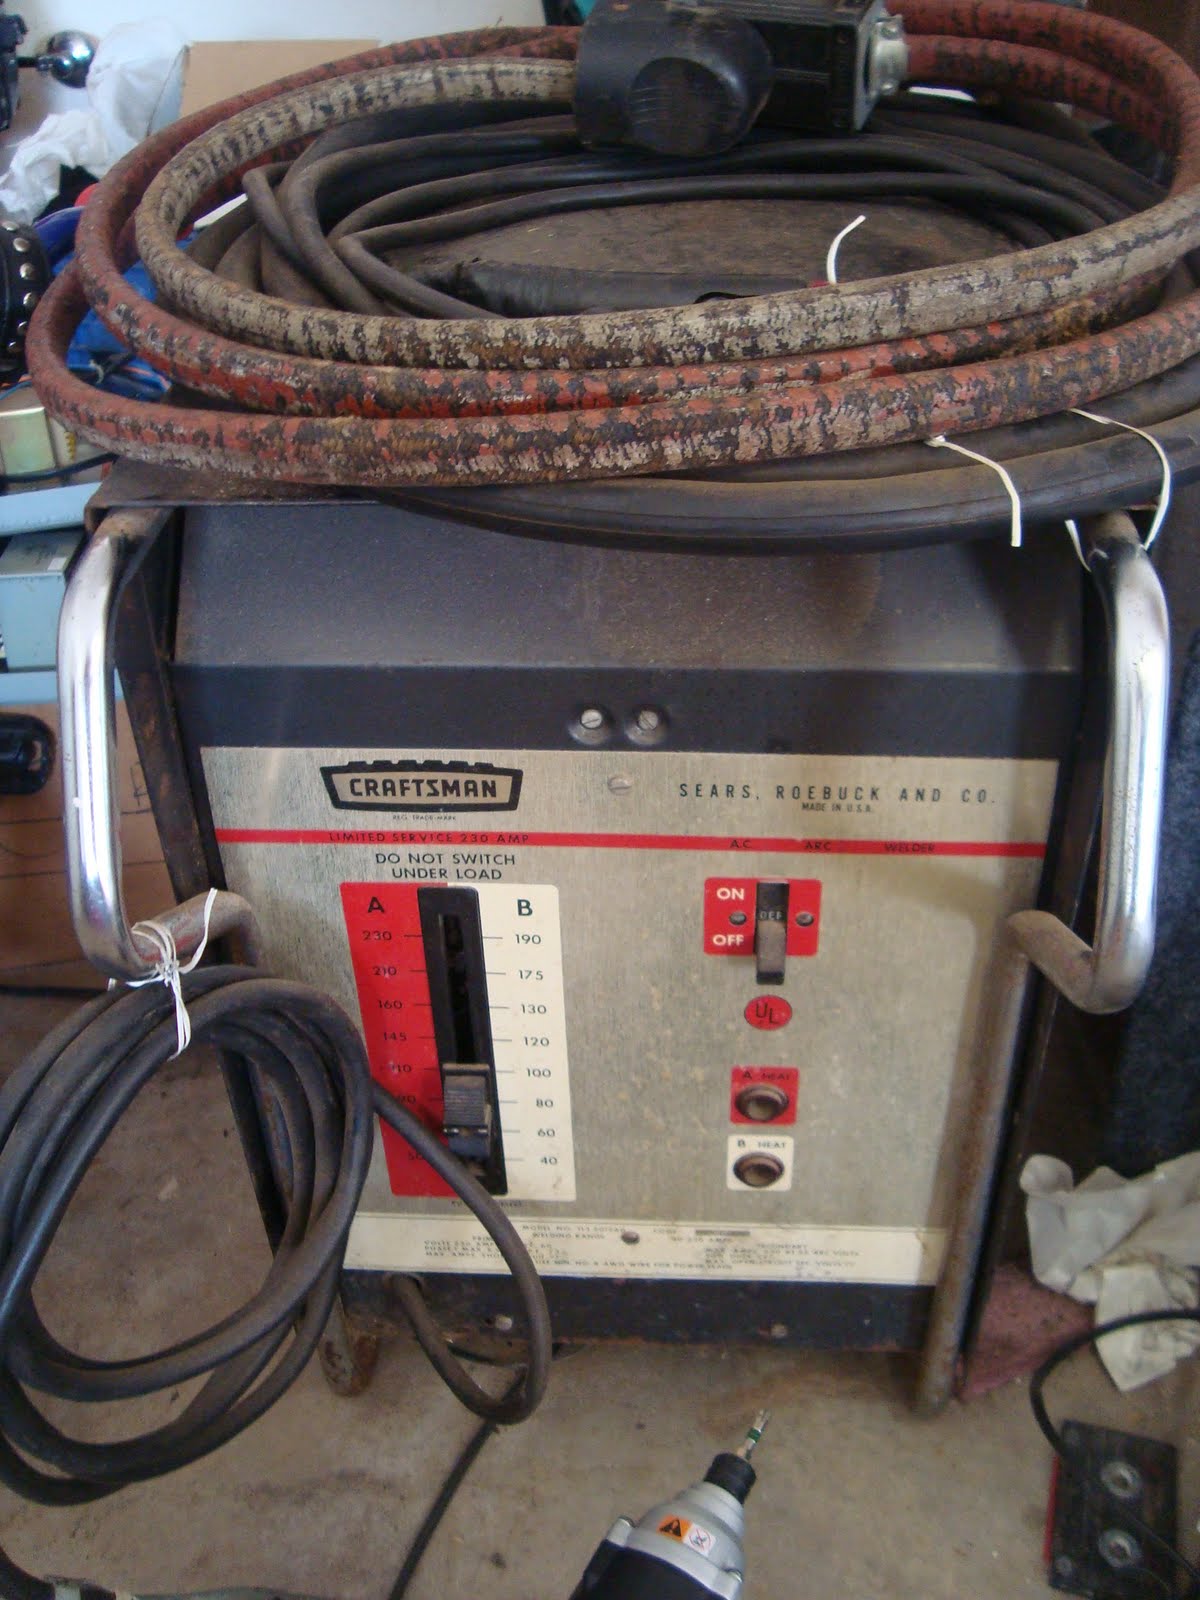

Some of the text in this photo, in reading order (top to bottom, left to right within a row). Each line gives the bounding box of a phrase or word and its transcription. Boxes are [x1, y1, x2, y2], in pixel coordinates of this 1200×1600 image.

[349, 777, 498, 799] CRAFTSMAN
[679, 783, 996, 804] SEARS, ROEBUCK AND CO.
[801, 802, 826, 812] MADE
[831, 803, 842, 812] IN
[328, 832, 529, 844] LIMITED SERVICE 230 AMP
[804, 841, 832, 851] ARC
[884, 842, 935, 853] WELDER
[375, 853, 516, 865] DO NOT SWITCH
[392, 868, 503, 881] UNDER LOAD
[716, 887, 745, 900] ON
[367, 897, 386, 913] A
[517, 899, 534, 916] B
[362, 931, 393, 941] 230
[515, 934, 542, 945] 190
[712, 934, 745, 946] OFF
[372, 966, 398, 976] 210
[518, 970, 544, 981] 175
[378, 1000, 404, 1010] 160
[521, 1004, 547, 1015] 130
[755, 1002, 779, 1024] UL
[383, 1032, 408, 1042] 145
[524, 1036, 550, 1048] 120
[526, 1068, 552, 1079] 100
[536, 1099, 554, 1109] 80
[538, 1128, 556, 1138] 60
[540, 1156, 558, 1166] 40
